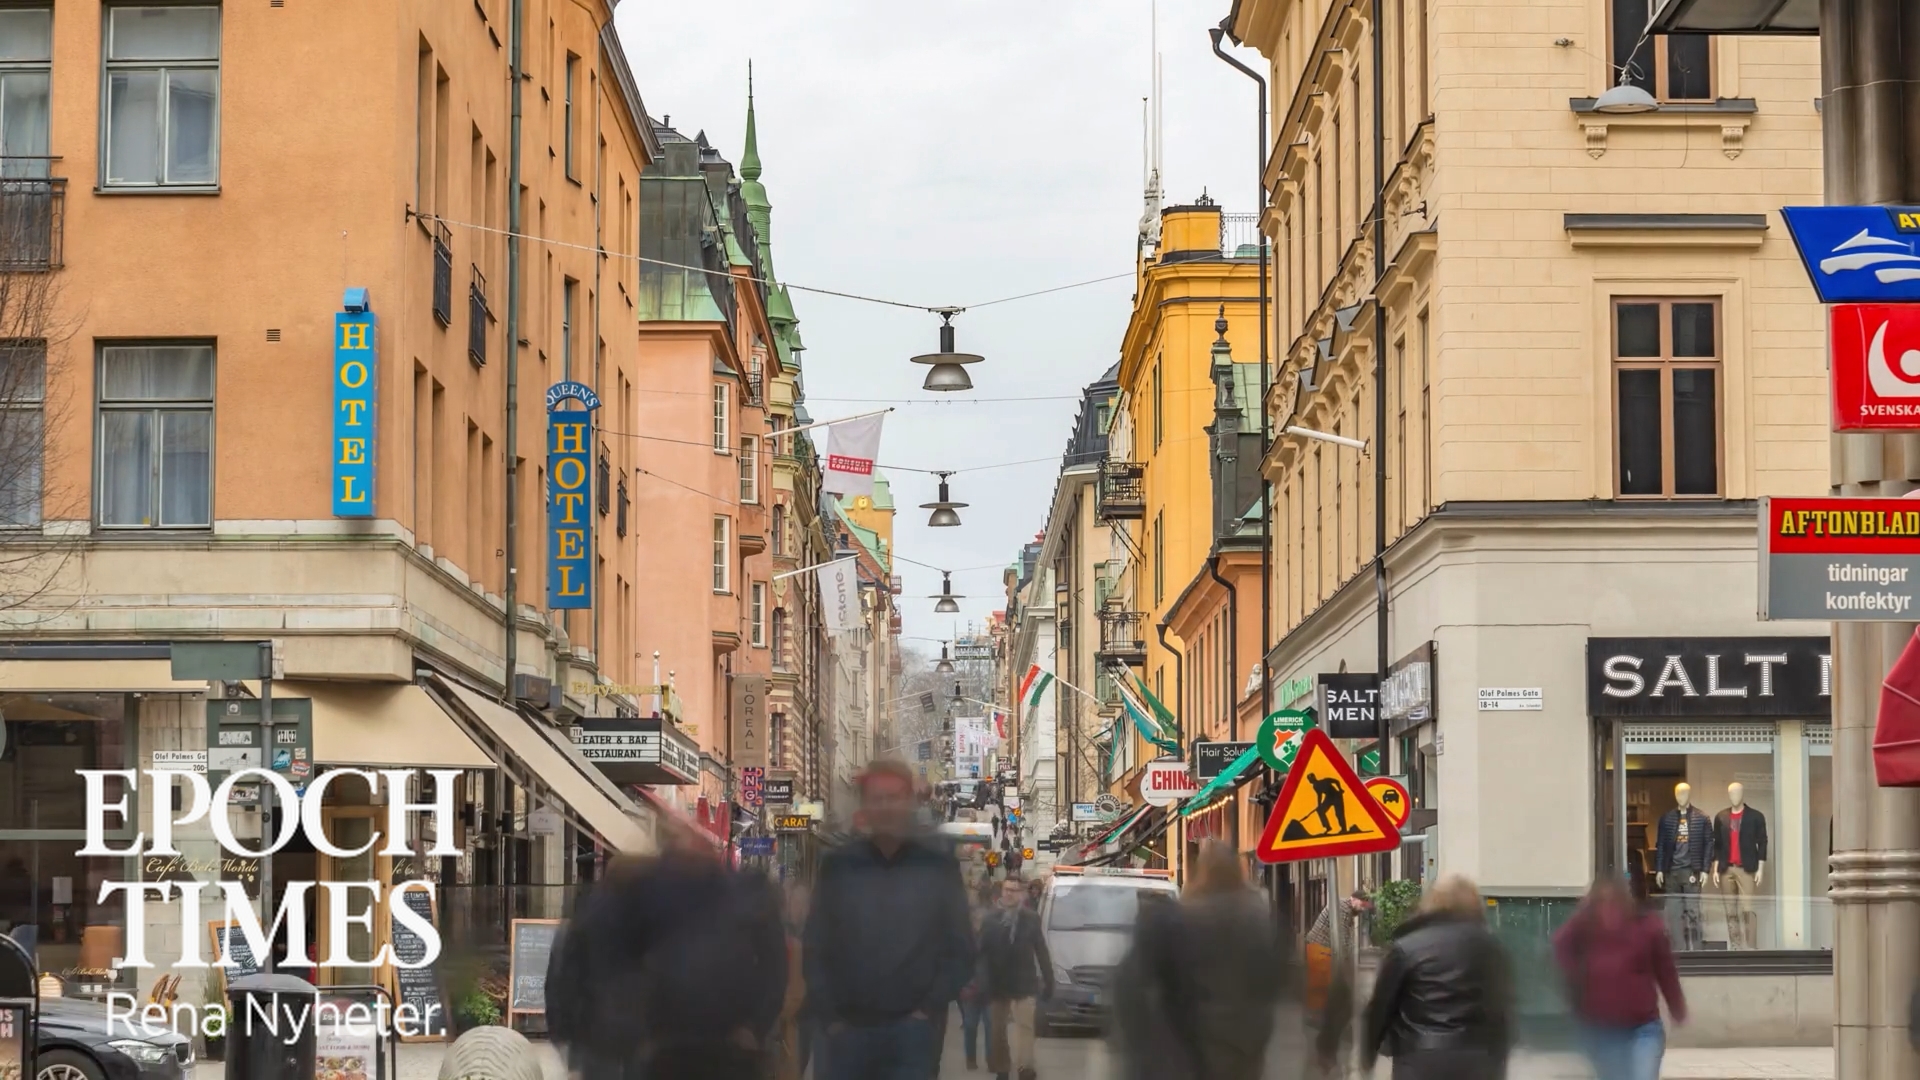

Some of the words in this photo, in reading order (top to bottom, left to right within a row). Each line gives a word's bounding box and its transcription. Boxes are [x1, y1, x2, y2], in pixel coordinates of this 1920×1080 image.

[547, 384, 599, 407] QUEEN'S
[339, 322, 370, 503] HOTEL
[1860, 404, 1920, 416] SVENSKA
[552, 423, 587, 597] HOTEL
[1780, 510, 1920, 535] AFTONBLAD
[1827, 563, 1909, 586] tidningar
[1825, 592, 1912, 613] konfektyr
[1602, 653, 1788, 698] SALT
[1327, 689, 1378, 703] SALT
[1496, 689, 1521, 697] Palmes
[1522, 689, 1539, 697] Gata
[1328, 707, 1375, 721] MEN
[616, 735, 623, 744] &
[628, 735, 648, 744] BAR
[171, 752, 194, 760] Palmes
[582, 749, 642, 758] RESTAURANT
[1200, 747, 1221, 757] Hair
[1152, 770, 1198, 790] CHINA
[774, 817, 809, 827] CARAT
